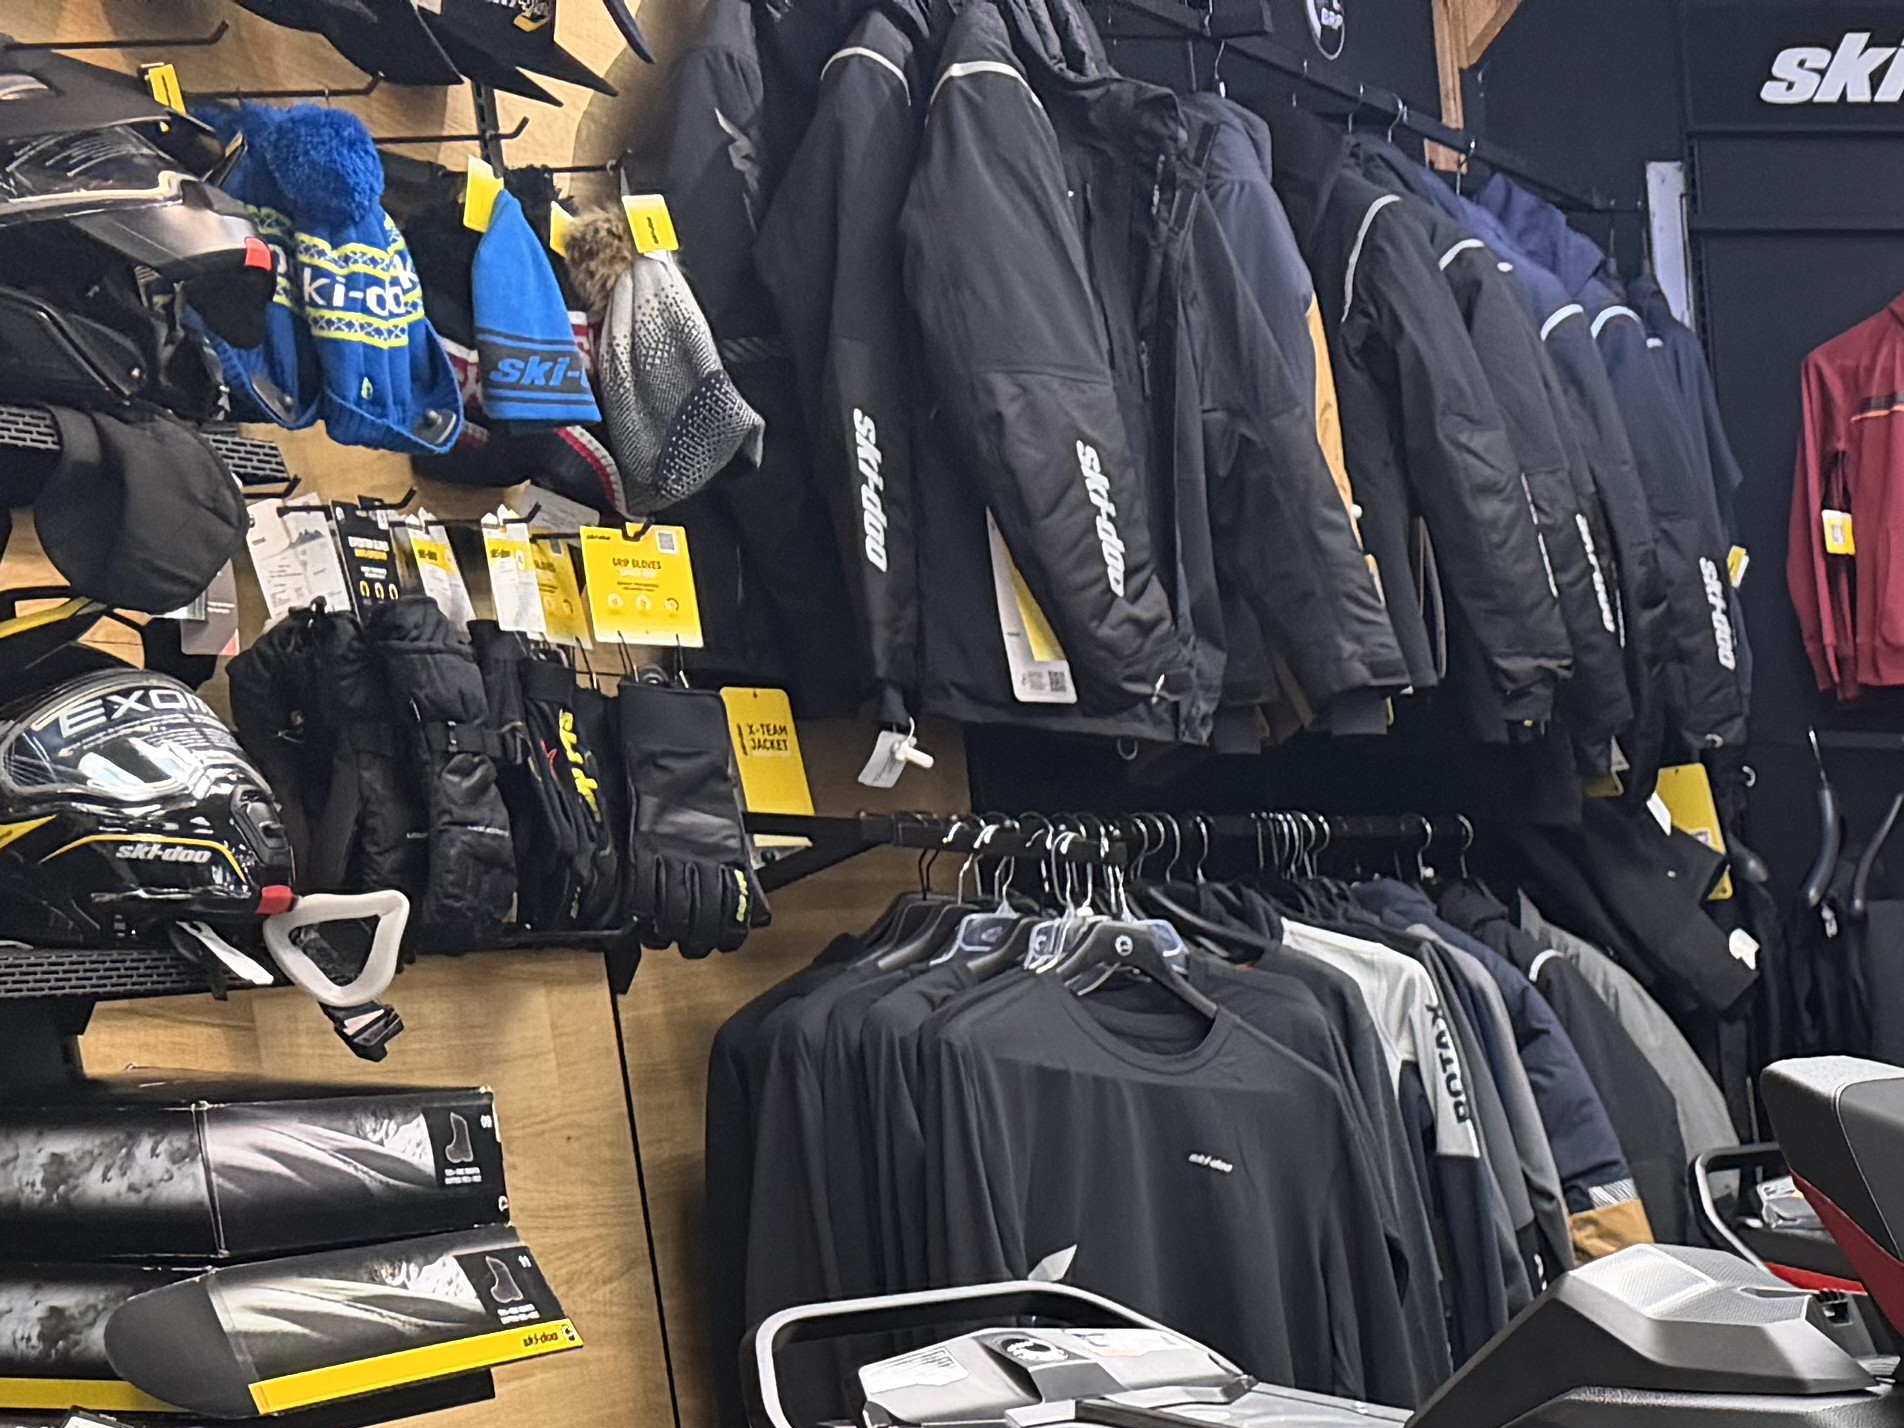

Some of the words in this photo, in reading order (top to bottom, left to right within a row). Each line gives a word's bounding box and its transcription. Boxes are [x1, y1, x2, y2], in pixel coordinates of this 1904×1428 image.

[853, 407, 888, 573] ski-doo
[1076, 439, 1126, 598] ski-doo
[115, 844, 212, 865] ski-doo
